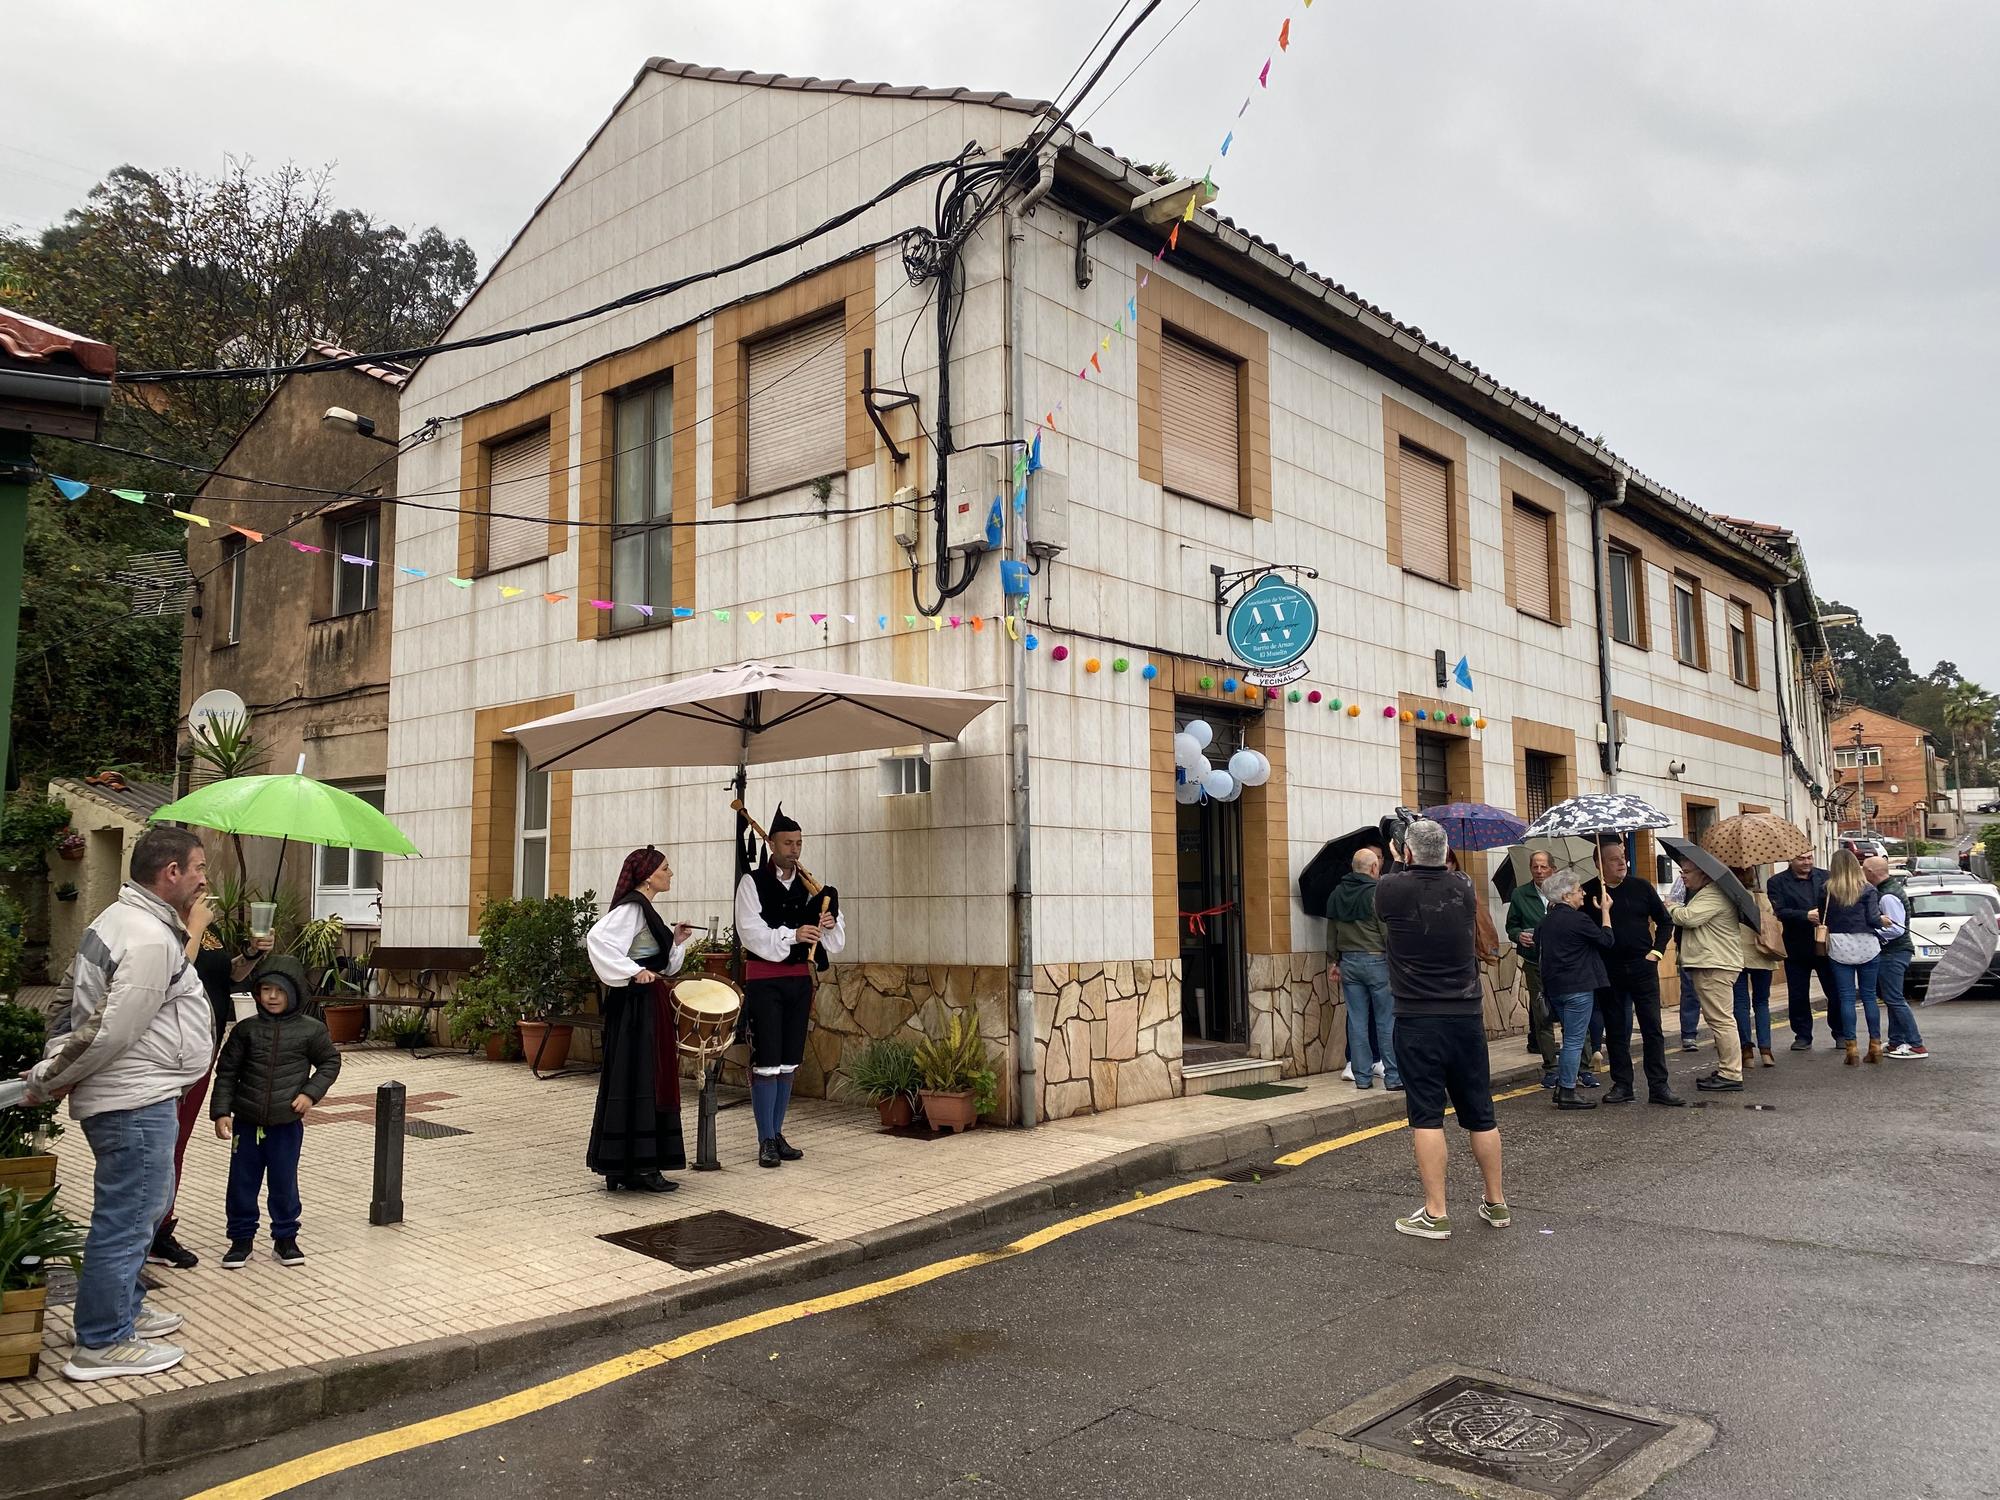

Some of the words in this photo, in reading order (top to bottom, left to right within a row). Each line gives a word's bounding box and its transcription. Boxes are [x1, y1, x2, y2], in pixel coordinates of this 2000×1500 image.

[1240, 600, 1302, 645] AV
[1252, 671, 1276, 679] CENTRO
[1279, 665, 1300, 677] SOCIAL
[1260, 675, 1294, 685] VECINAL
